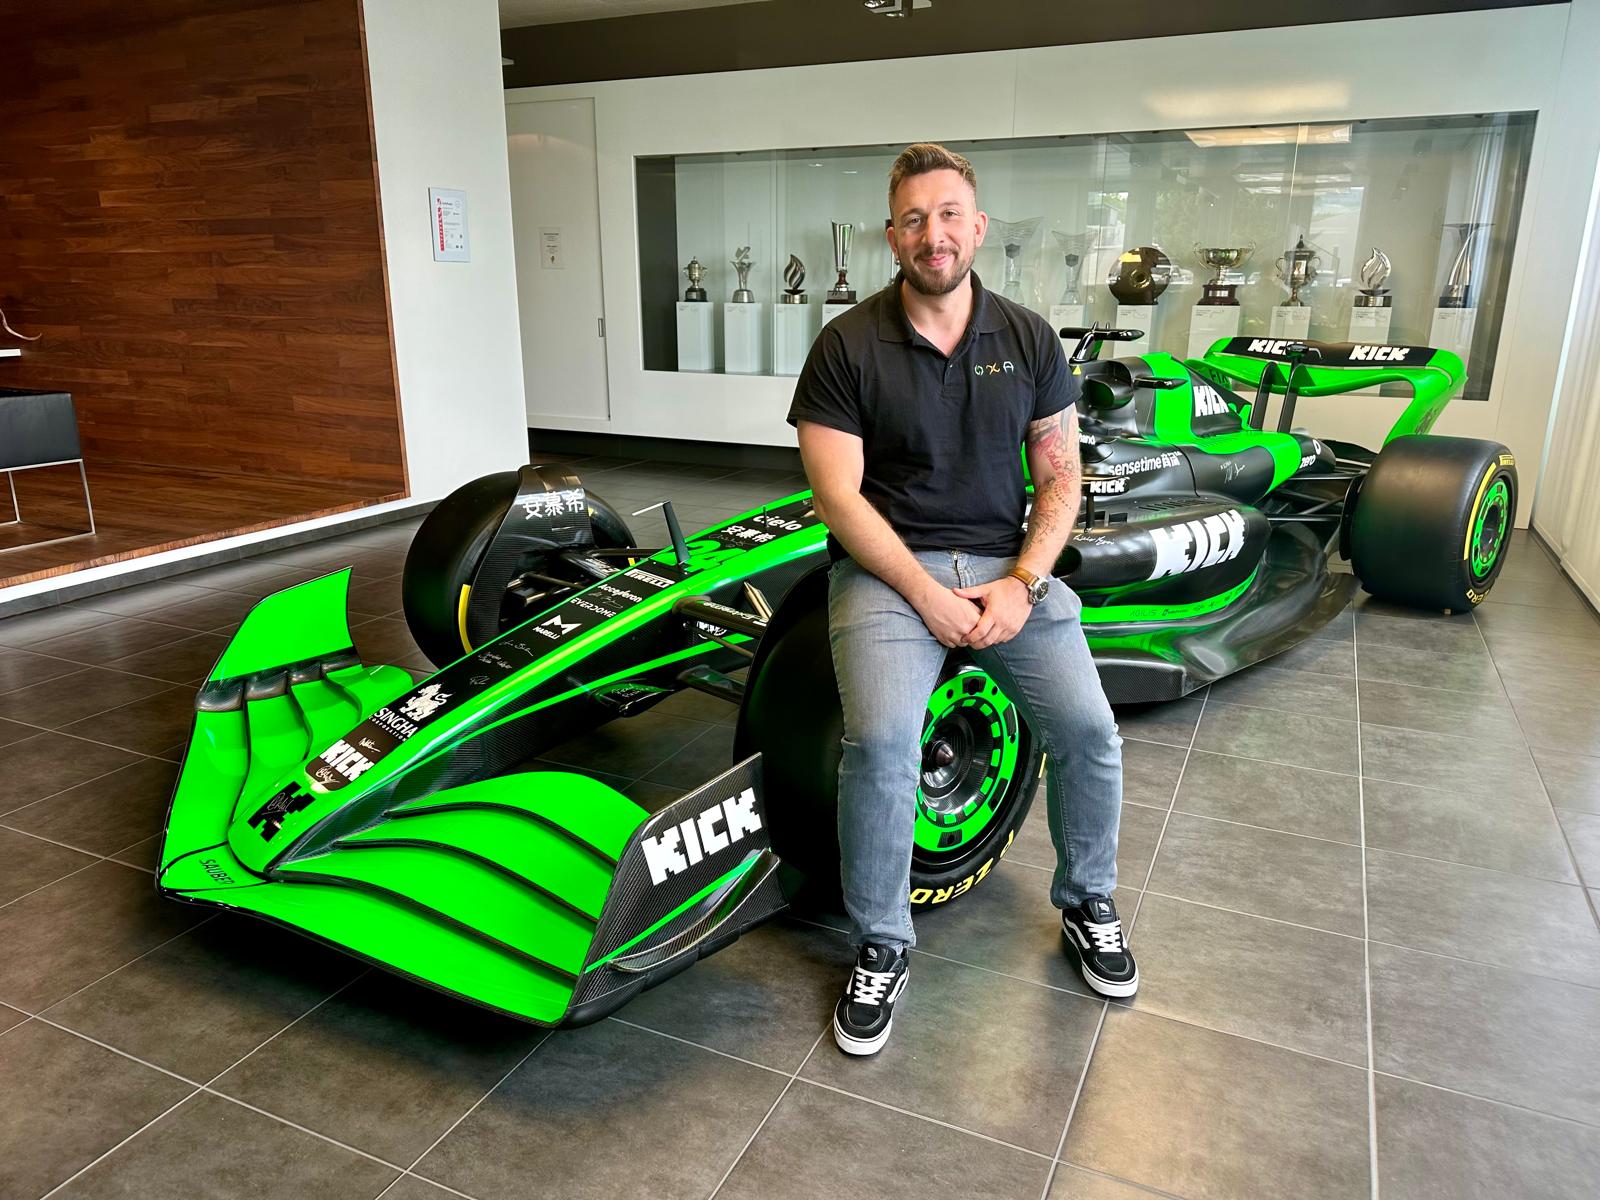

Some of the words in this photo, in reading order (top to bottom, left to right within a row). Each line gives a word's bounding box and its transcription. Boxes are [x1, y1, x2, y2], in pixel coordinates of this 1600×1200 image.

[1349, 345, 1410, 361] KICK
[1108, 456, 1161, 475] sensetime
[1089, 478, 1126, 493] KICK
[753, 516, 802, 530] cielo
[1148, 509, 1246, 581] KICK
[624, 568, 675, 588] PIRELLI
[570, 597, 617, 618] EVERDOME
[532, 626, 561, 640] MARELLI
[374, 707, 418, 738] SINGHA
[319, 739, 375, 782] KICK
[641, 787, 762, 886] KICK
[199, 859, 235, 884] SAUBER
[910, 857, 994, 904] ZERO
